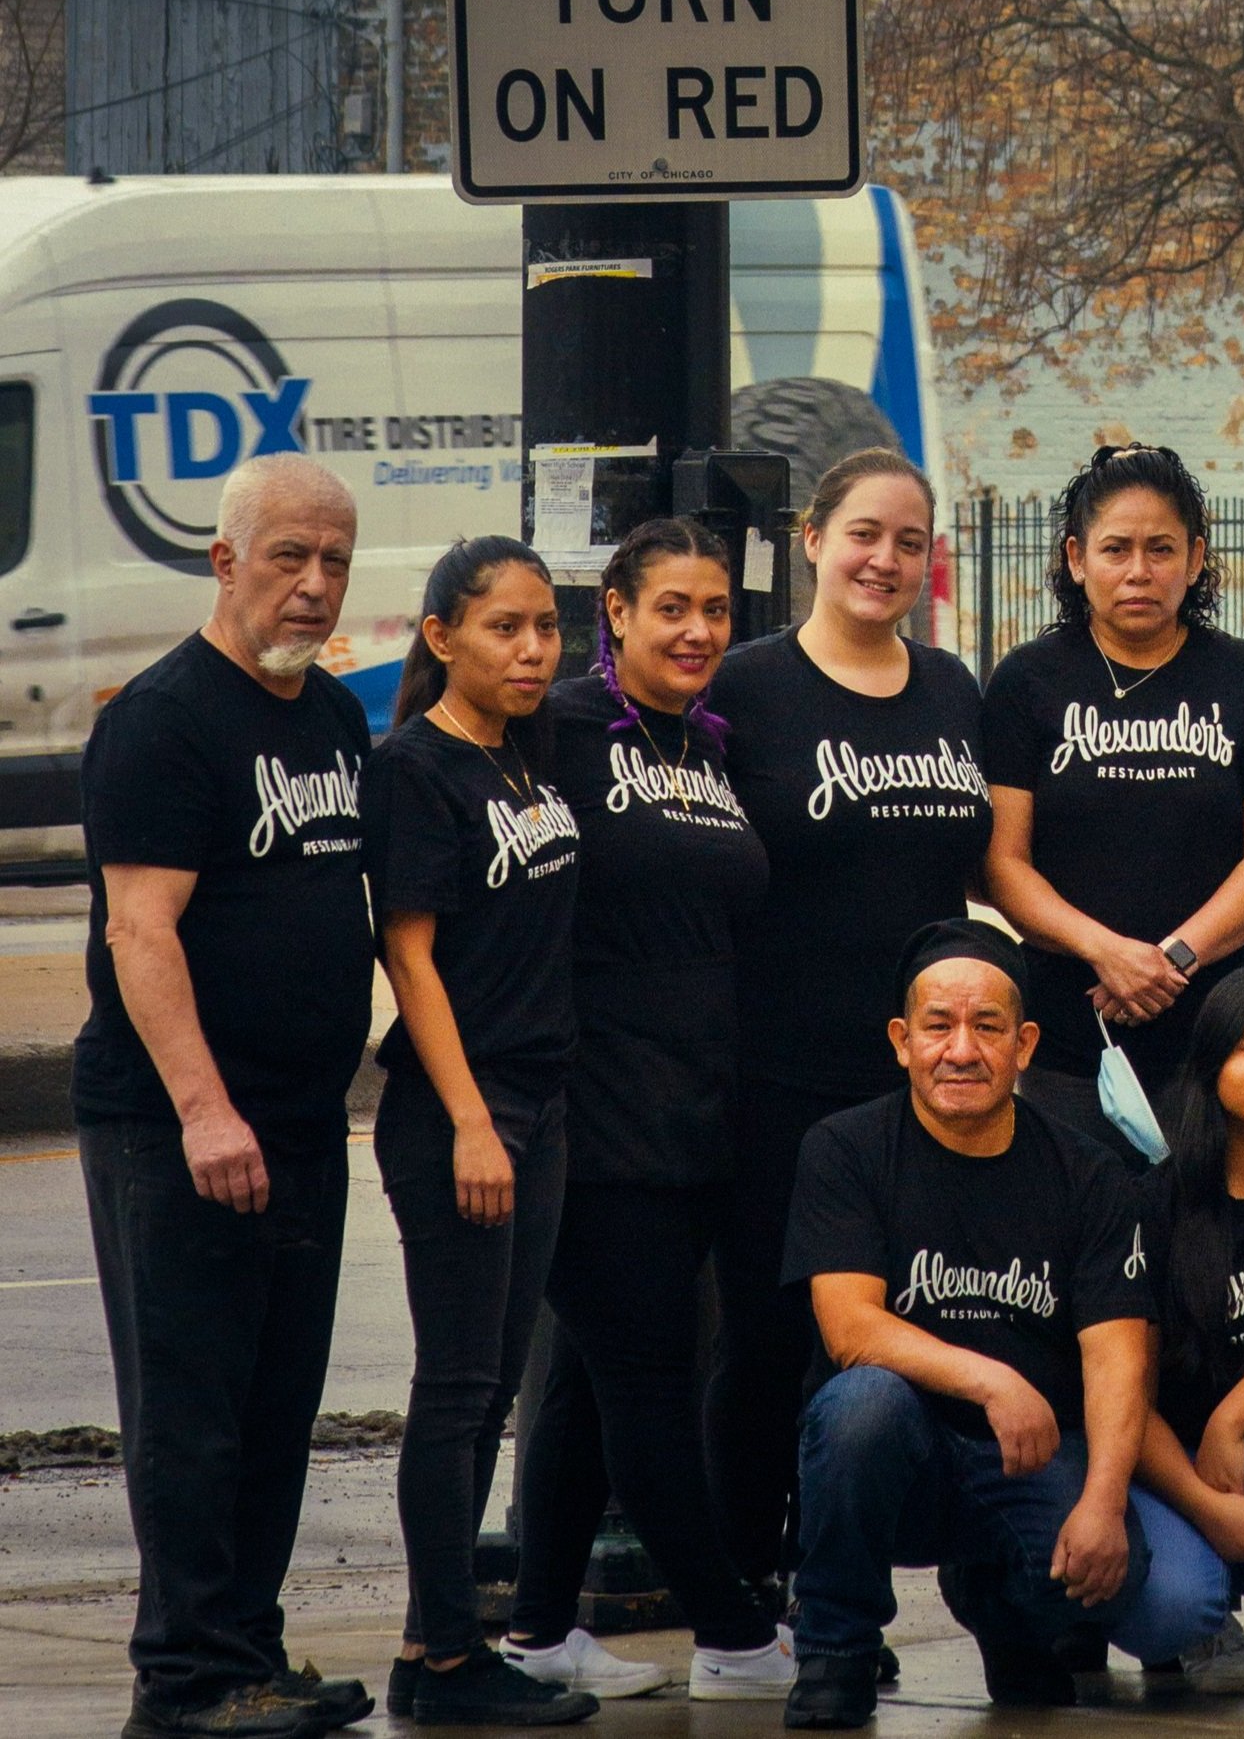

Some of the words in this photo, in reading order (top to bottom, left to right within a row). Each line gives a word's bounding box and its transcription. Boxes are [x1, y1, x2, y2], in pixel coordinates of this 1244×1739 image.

[495, 67, 606, 143] ON
[666, 65, 824, 140] RED
[608, 171, 633, 180] CITY
[640, 171, 655, 180] OF
[662, 170, 714, 180] CHICAGO
[566, 264, 581, 272] PARK
[581, 263, 622, 271] FURNITURES
[86, 376, 313, 485] TDX
[313, 417, 377, 452] TIRE
[373, 460, 493, 490] Delivering
[1050, 701, 1236, 776] Alexander's
[807, 736, 993, 821] Alexander's
[1097, 765, 1197, 781] RESTAURANT
[661, 807, 744, 831] RESTAURANT
[870, 804, 976, 819] RESTAURANT
[895, 1247, 1060, 1320] Alexander's
